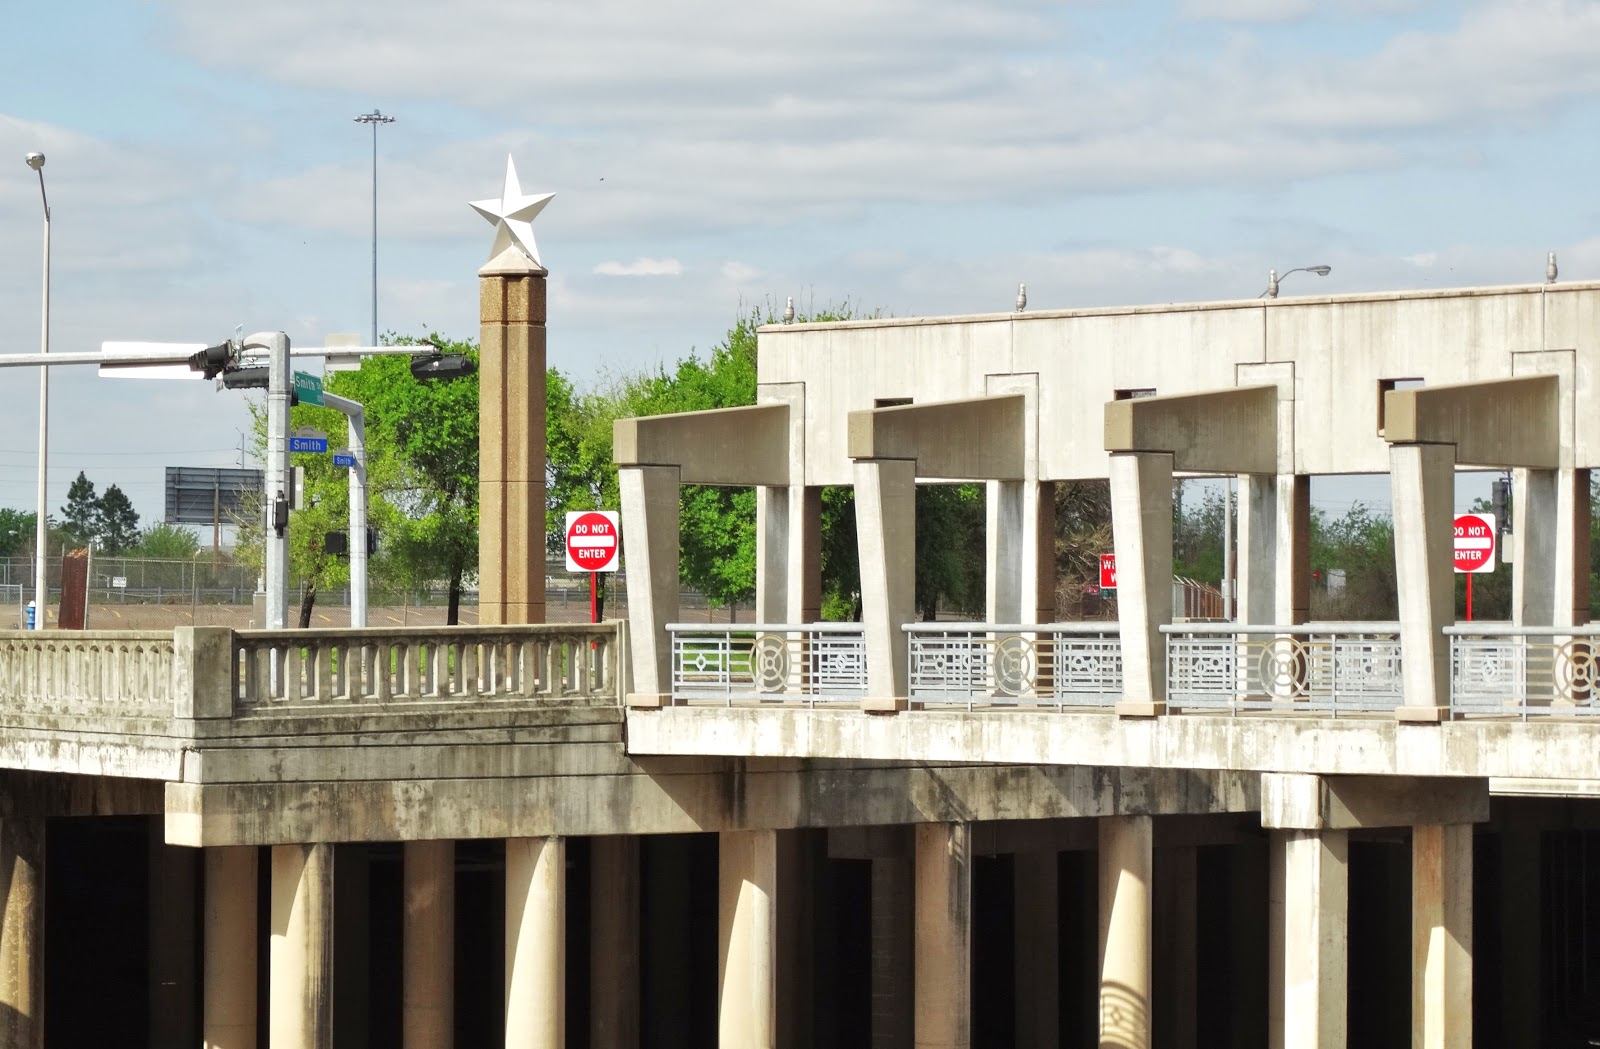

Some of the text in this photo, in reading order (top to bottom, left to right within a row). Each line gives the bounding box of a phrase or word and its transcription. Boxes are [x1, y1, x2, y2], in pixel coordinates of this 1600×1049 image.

[295, 375, 316, 391] Smith
[294, 439, 321, 450] Smith
[336, 456, 352, 465] Smith
[575, 524, 609, 534] DO NOT
[1468, 526, 1486, 536] NOT
[578, 548, 606, 559] ENTER
[1454, 550, 1482, 560] ENTER
